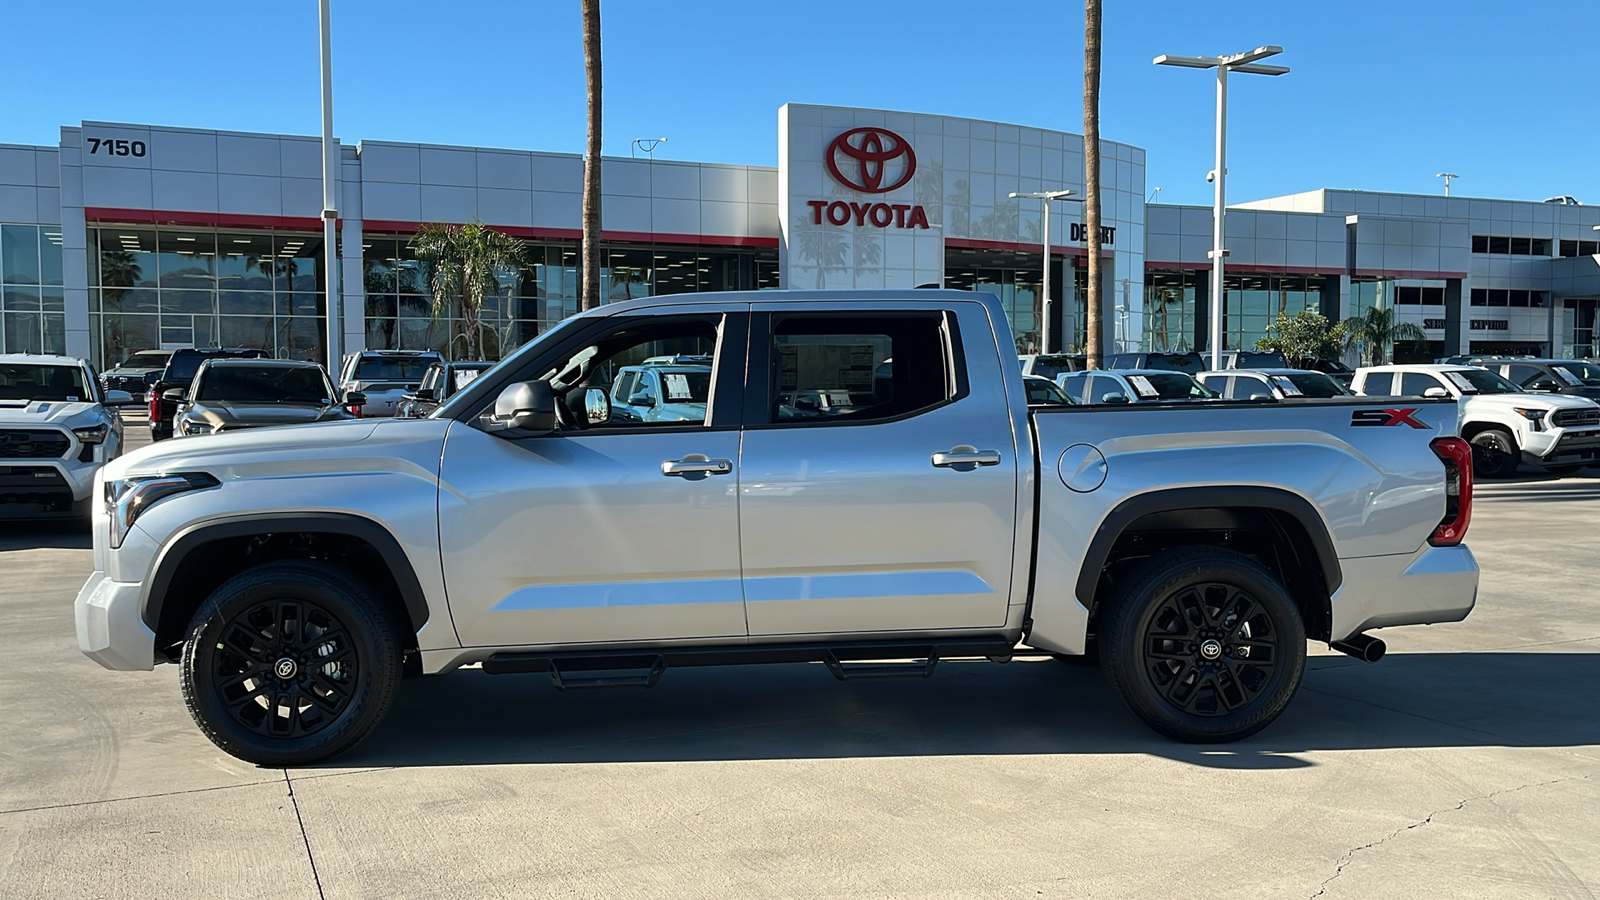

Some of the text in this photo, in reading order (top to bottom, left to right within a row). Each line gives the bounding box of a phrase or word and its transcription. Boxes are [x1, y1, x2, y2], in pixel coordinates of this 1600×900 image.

[87, 138, 146, 157] 7150
[807, 200, 930, 229] TOYOTA
[1070, 223, 1116, 245] DERT
